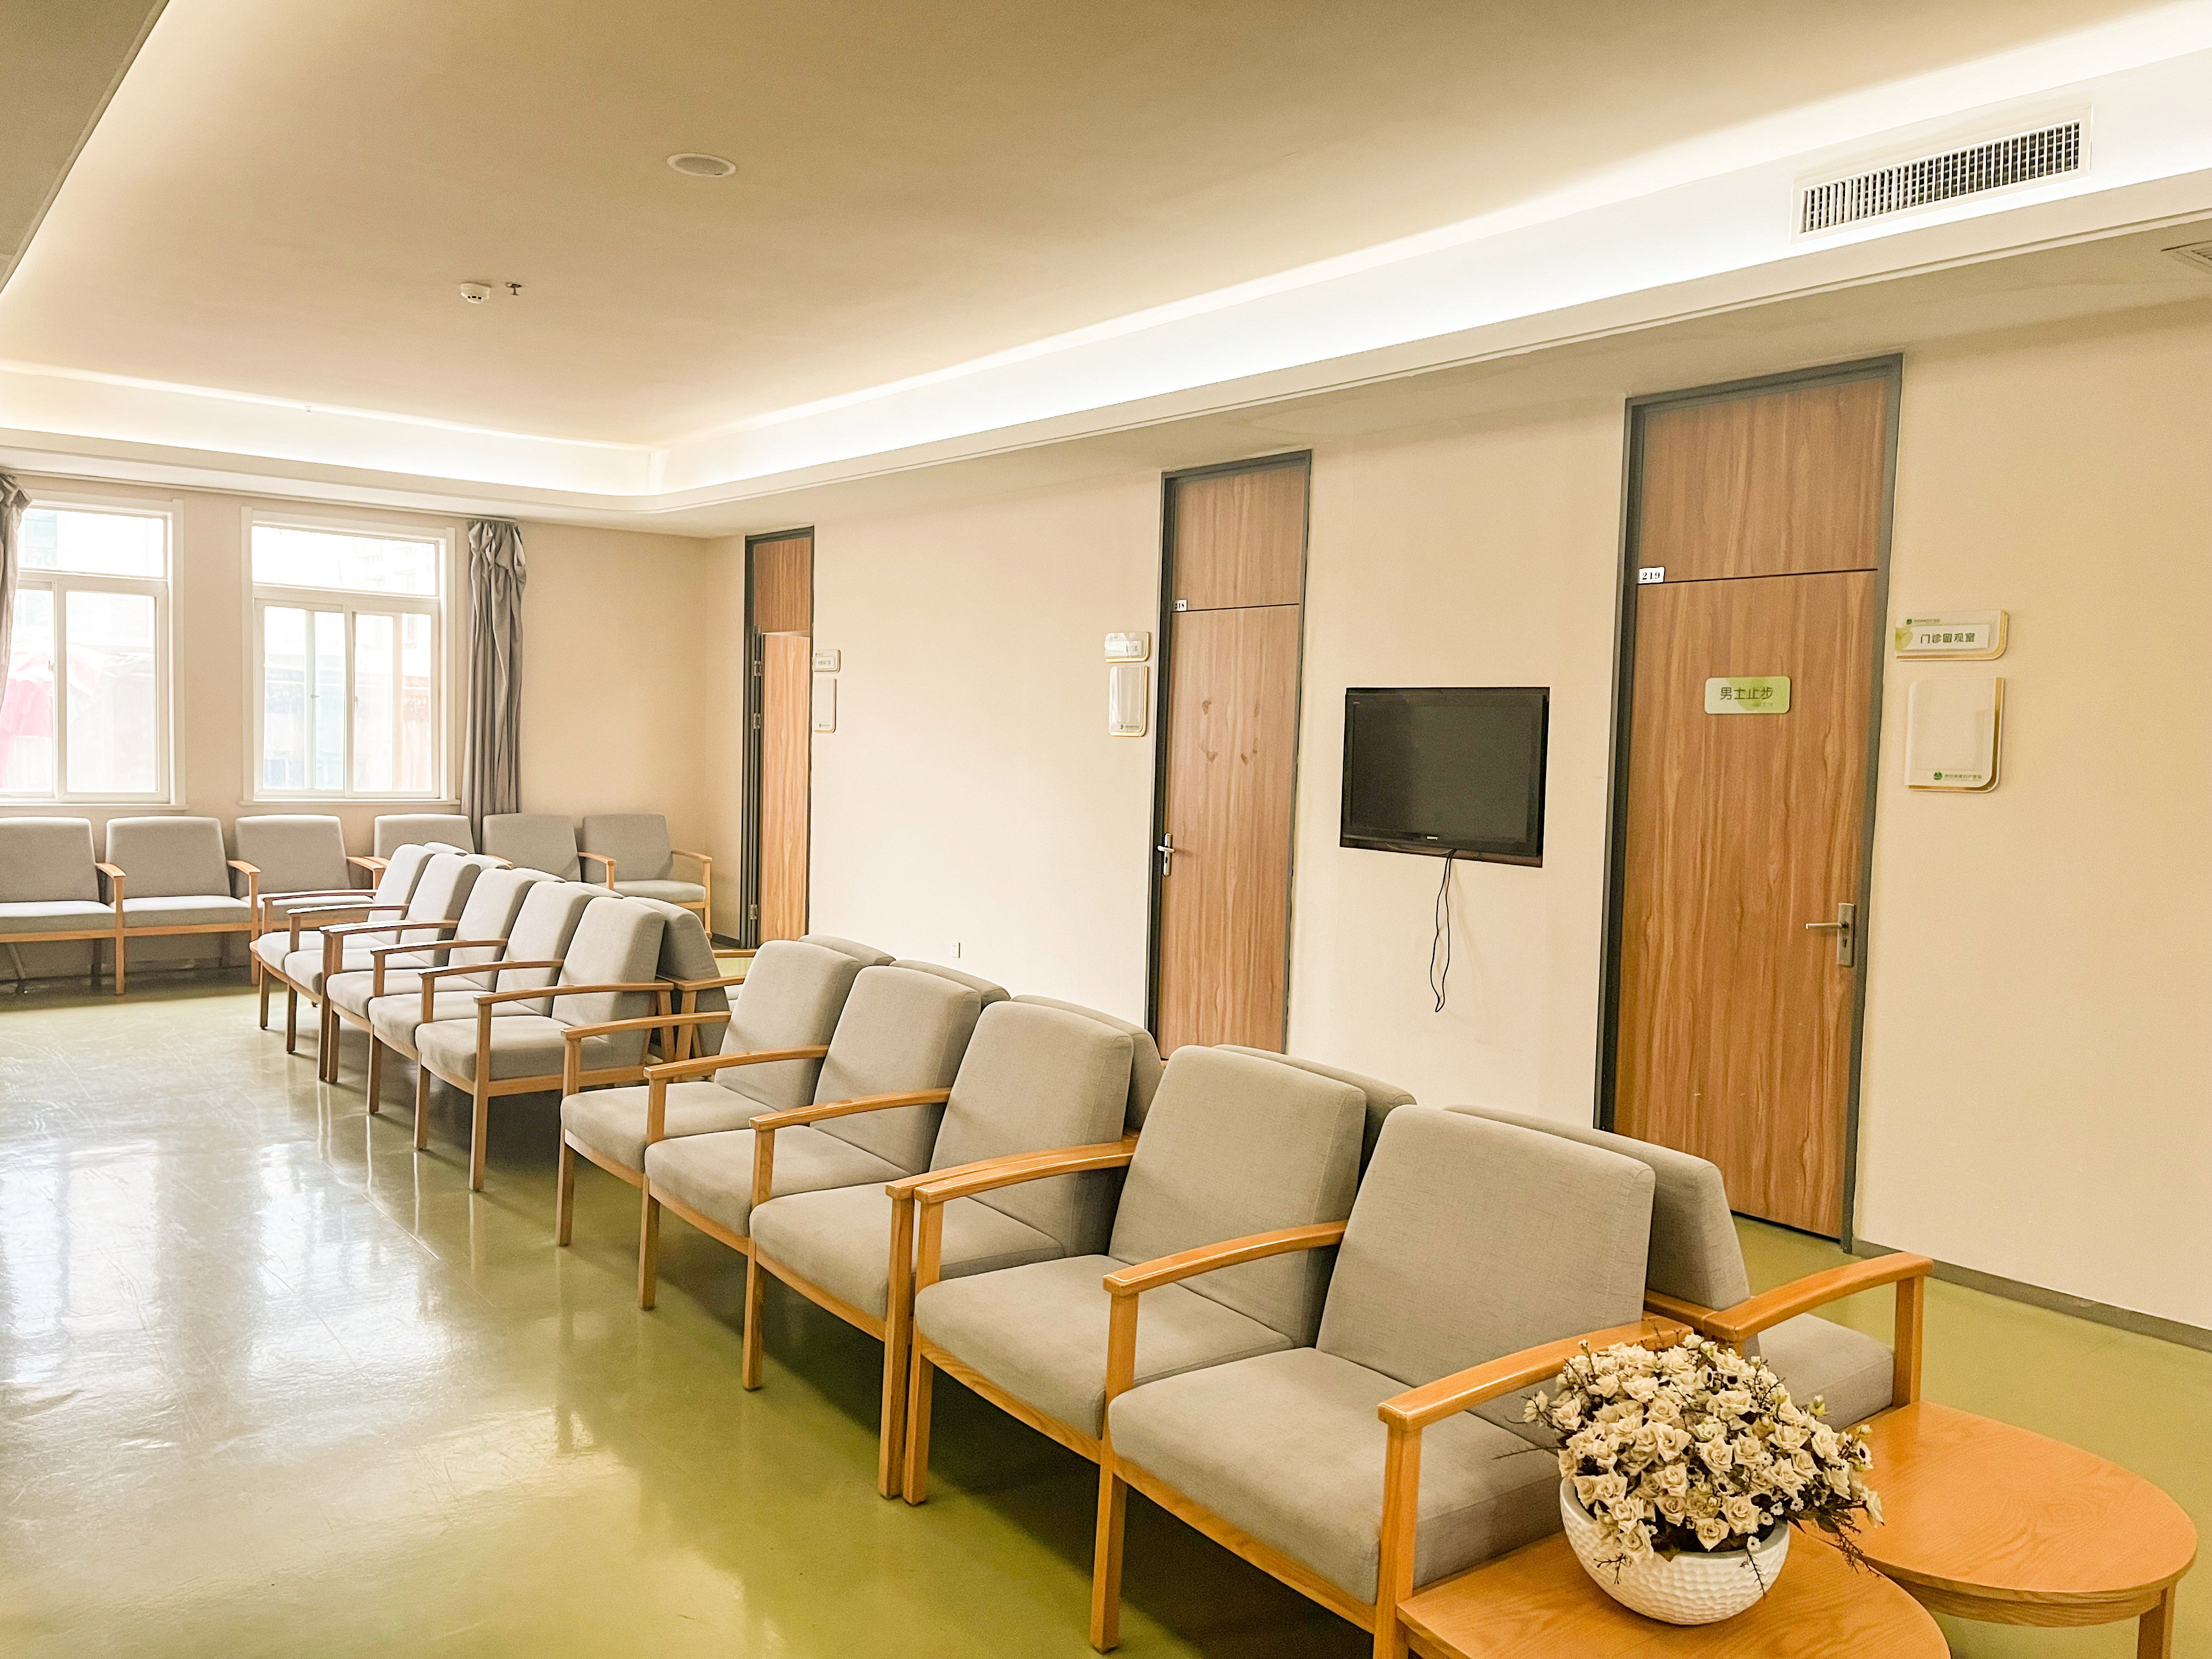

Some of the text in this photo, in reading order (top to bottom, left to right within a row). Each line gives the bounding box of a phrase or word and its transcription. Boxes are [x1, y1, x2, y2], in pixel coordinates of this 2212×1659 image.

[1642, 572, 1660, 580] 219
[1921, 633, 1975, 644] 门诊留观室
[1720, 686, 1774, 700] 男士止步
